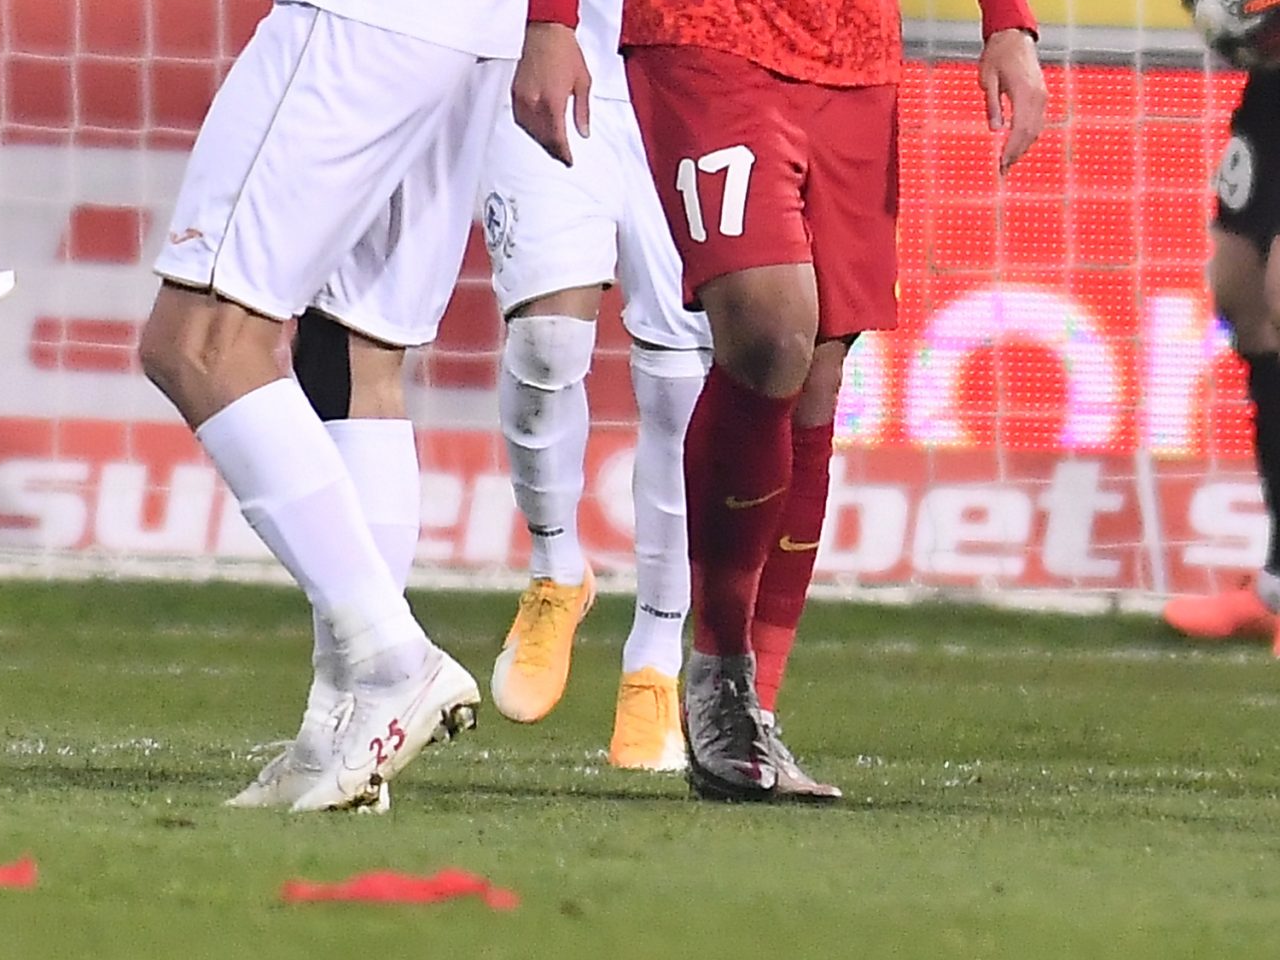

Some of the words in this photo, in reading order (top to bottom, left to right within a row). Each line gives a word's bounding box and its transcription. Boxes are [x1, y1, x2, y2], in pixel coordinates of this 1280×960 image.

[676, 144, 756, 243] 17
[817, 454, 1124, 578] bet
[369, 717, 406, 766] 25
